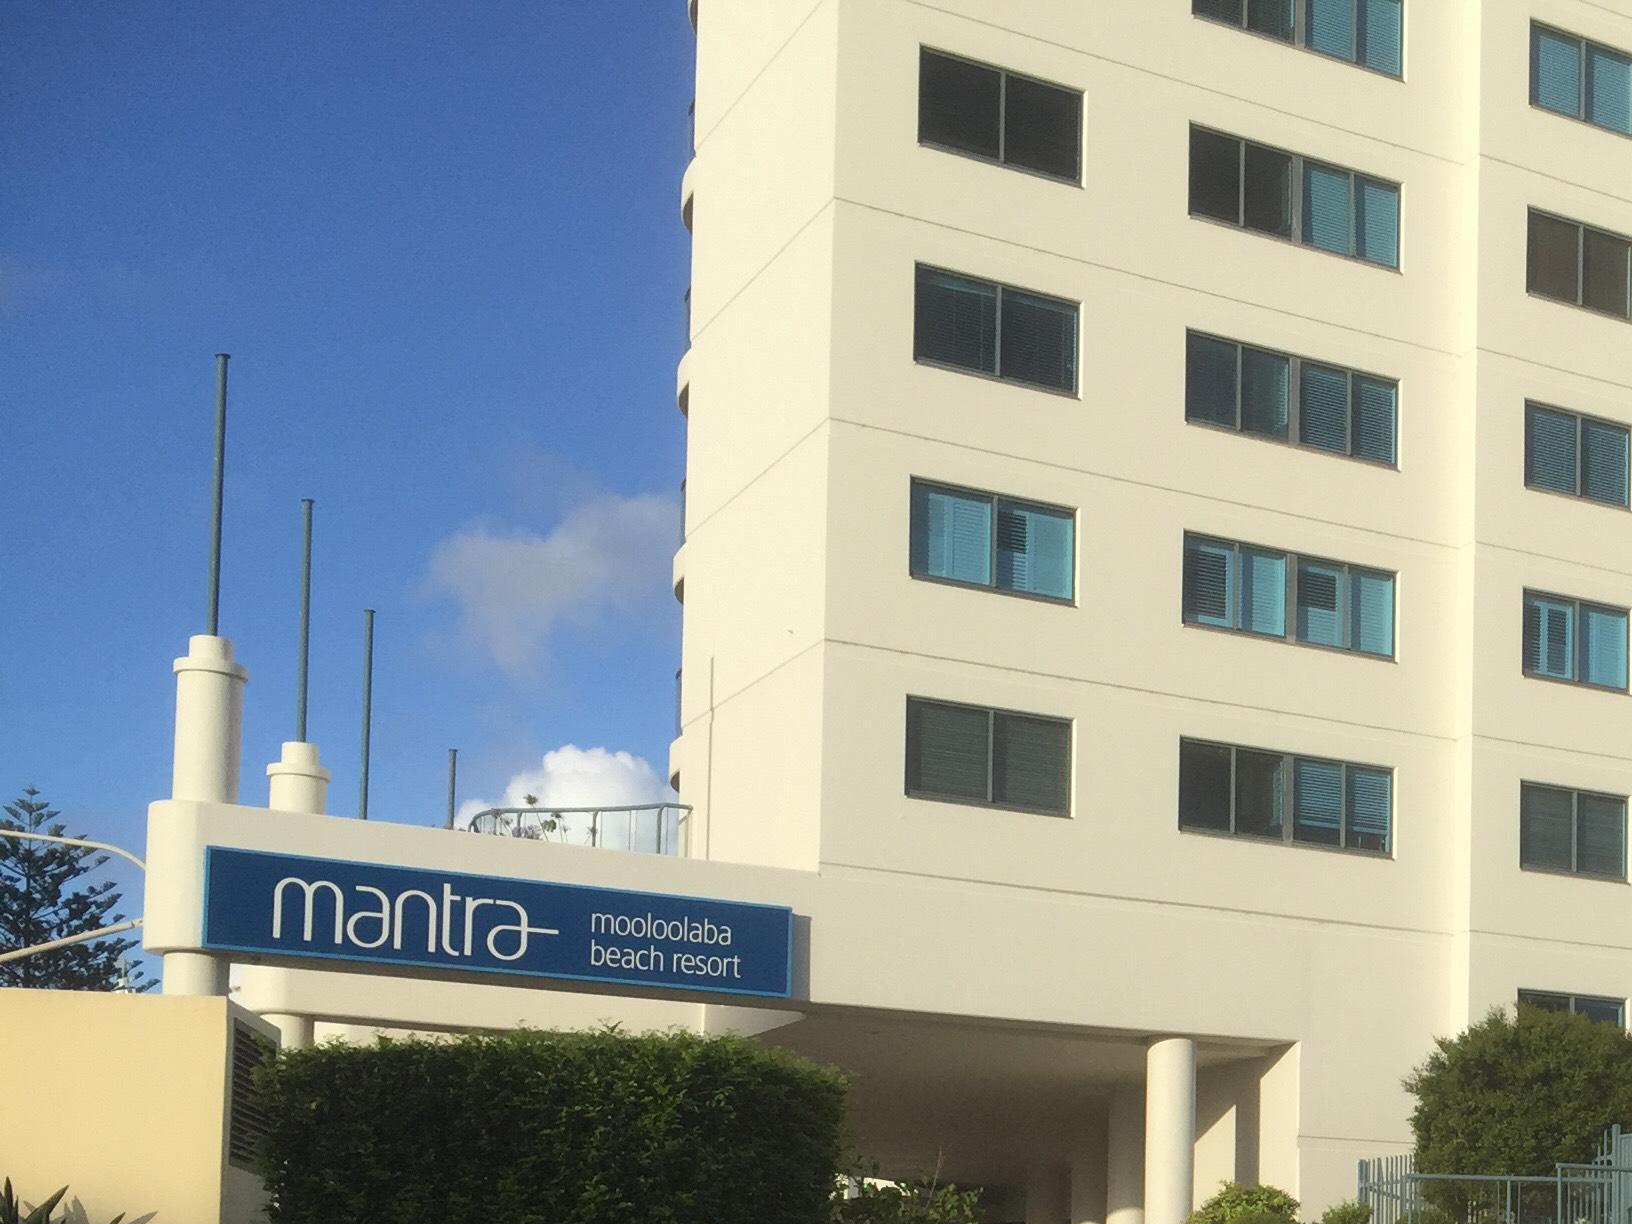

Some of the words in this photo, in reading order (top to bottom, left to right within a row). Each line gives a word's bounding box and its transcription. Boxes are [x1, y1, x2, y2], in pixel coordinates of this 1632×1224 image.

[272, 877, 559, 961] mantra
[590, 908, 732, 946] mooloolaba
[590, 943, 664, 972] beach
[673, 950, 741, 979] resort
